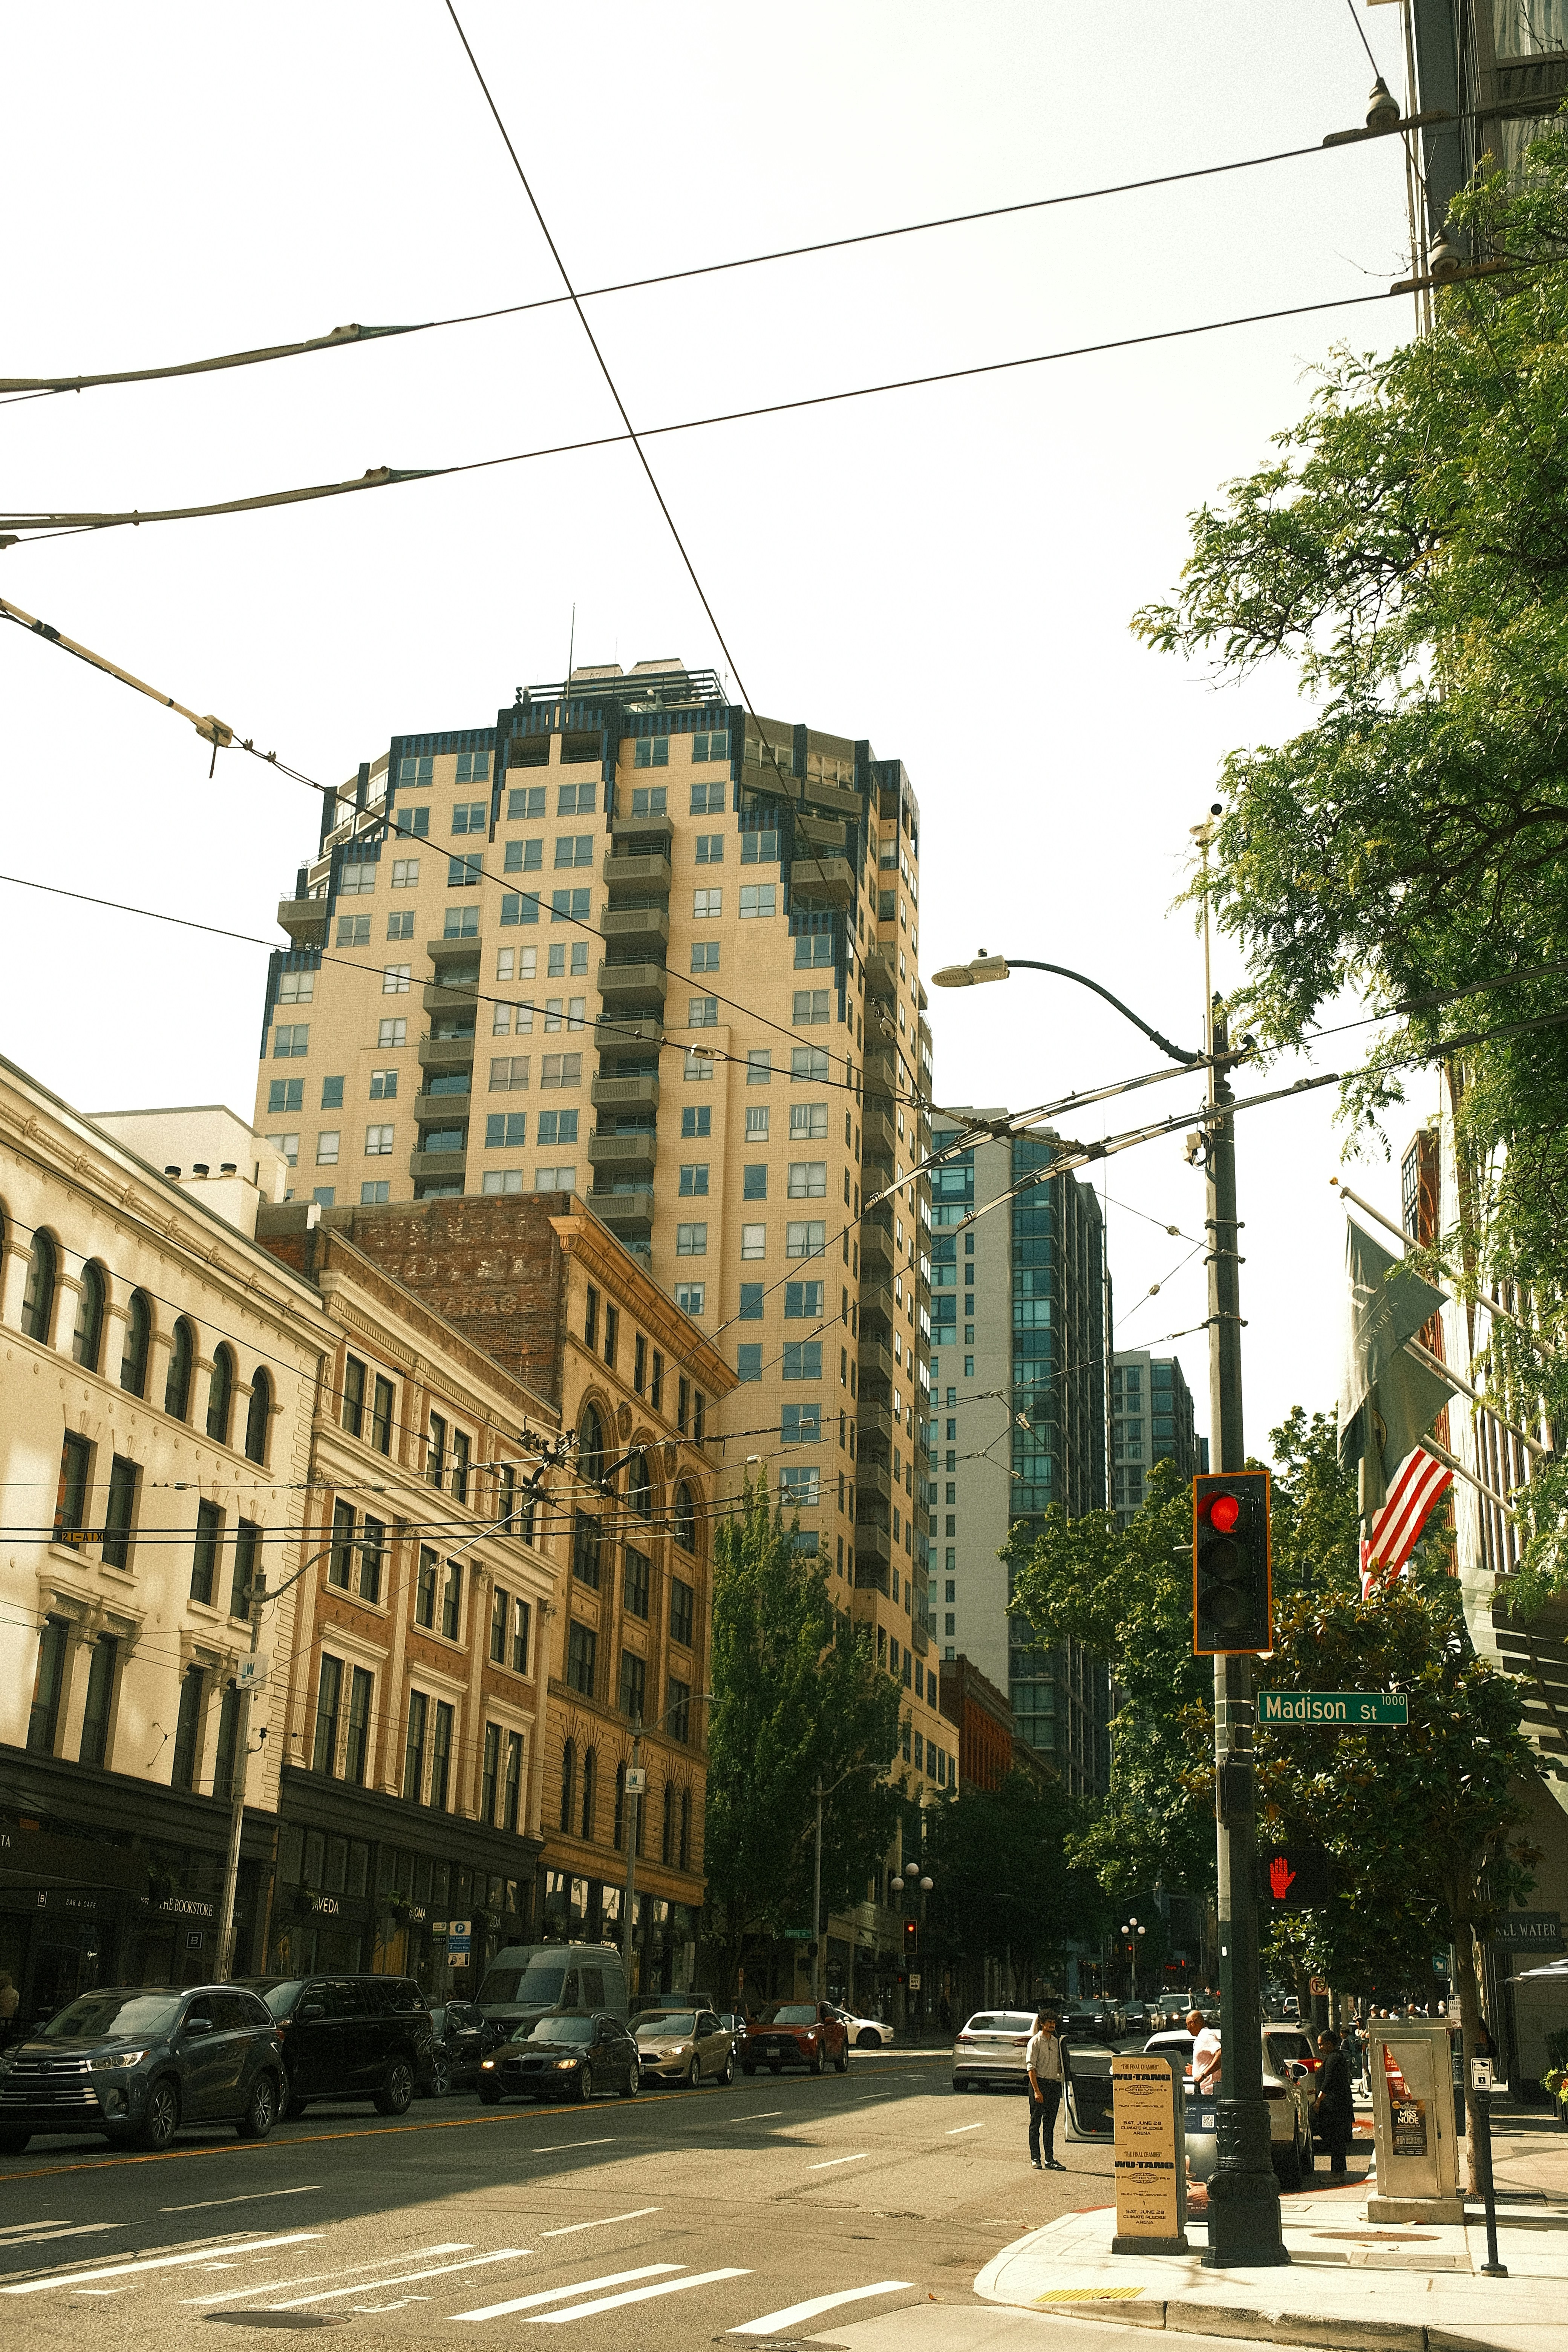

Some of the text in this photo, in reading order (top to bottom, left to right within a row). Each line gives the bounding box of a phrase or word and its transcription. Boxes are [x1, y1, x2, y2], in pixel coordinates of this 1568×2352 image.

[1359, 1302, 1399, 1352] RESORTS
[1266, 1696, 1377, 1720] Madison St
[1382, 1696, 1405, 1706] 1000
[174, 1899, 213, 1917] BOOKSTORE
[1519, 1923, 1556, 1937] WATER
